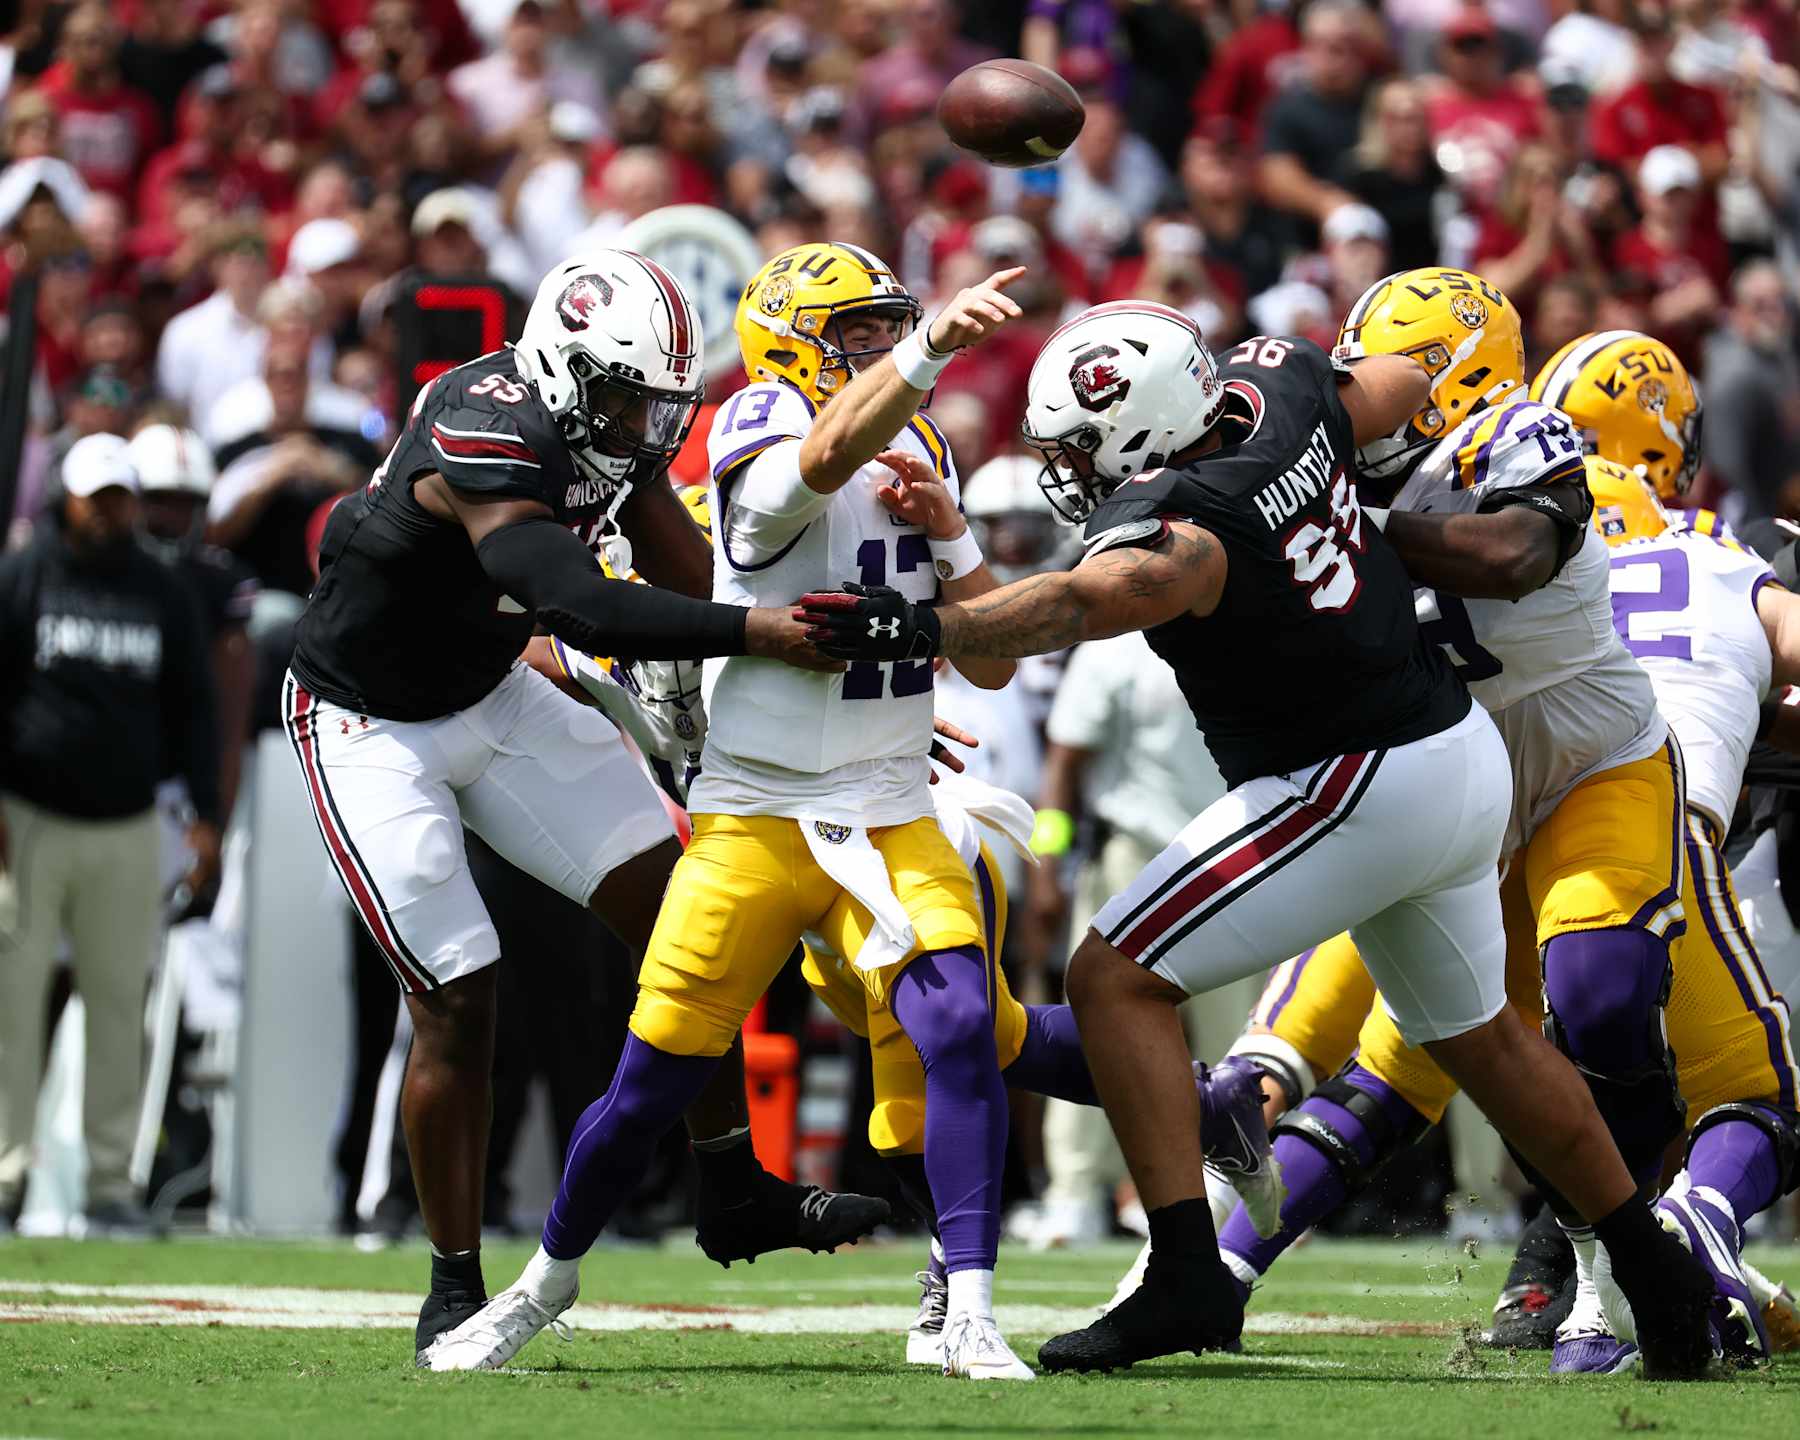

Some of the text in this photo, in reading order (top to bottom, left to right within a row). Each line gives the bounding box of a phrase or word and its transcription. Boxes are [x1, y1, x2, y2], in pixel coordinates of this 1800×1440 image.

[1405, 272, 1503, 307] LSU
[1334, 346, 1351, 358] LSU
[1594, 348, 1673, 400] LSU
[721, 390, 779, 436] 13
[1515, 412, 1576, 463] 79
[1253, 420, 1336, 531] HUNTLEY
